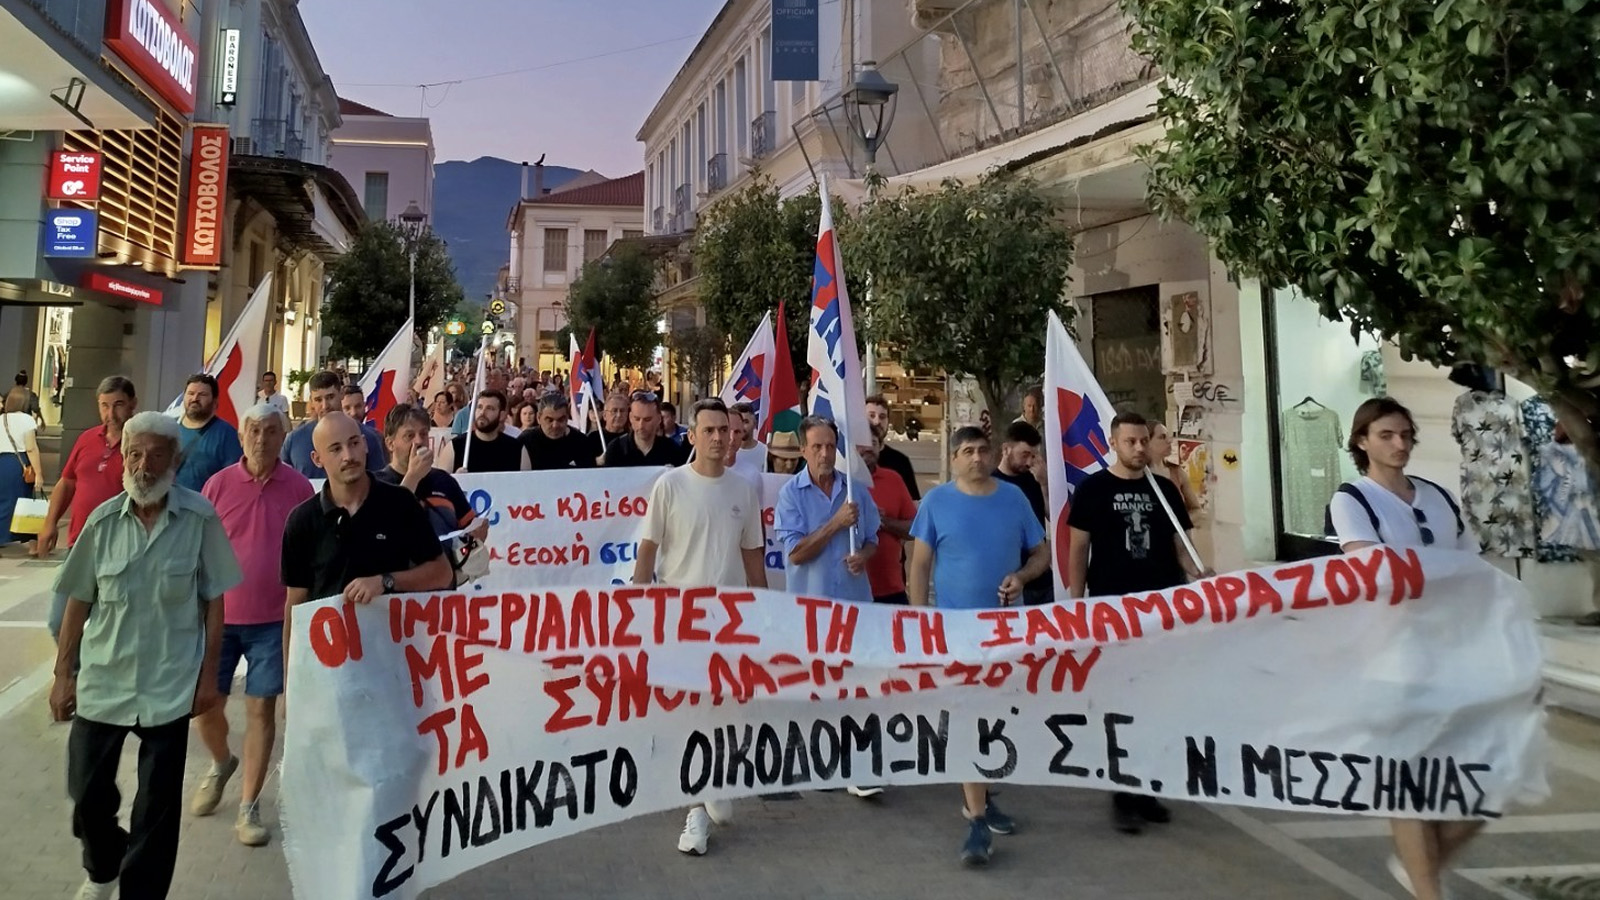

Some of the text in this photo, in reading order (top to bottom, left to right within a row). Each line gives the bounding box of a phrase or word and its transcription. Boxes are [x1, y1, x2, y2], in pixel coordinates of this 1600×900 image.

[776, 8, 815, 16] OFFICIUM
[129, 0, 195, 95] ΚΩΤΣΟΒΟΛΟΣ
[226, 35, 237, 91] BARONESS
[60, 154, 95, 164] Service
[63, 163, 90, 173] Point
[192, 135, 222, 256] ΚΩΤΣΟΒΟΛΟΣ
[56, 218, 78, 226] Shop
[56, 225, 71, 233] Tax
[57, 232, 77, 240] Free
[507, 504, 546, 521] να
[309, 543, 1427, 668] ΟΙ ΙΜΠΕΡΙΑΛΙΣΤΕΣ ΤΗ ΓΗ ΞΑΝΑΜΟΙΡΑΖΟΥΝ
[405, 635, 490, 708] ΜΕ
[418, 704, 489, 776] ΤΑ
[372, 746, 638, 899] ΣΥΝΔΙΚΑΤΟ
[680, 709, 950, 796] ΟΙΚΟΔΟΜΩΝ
